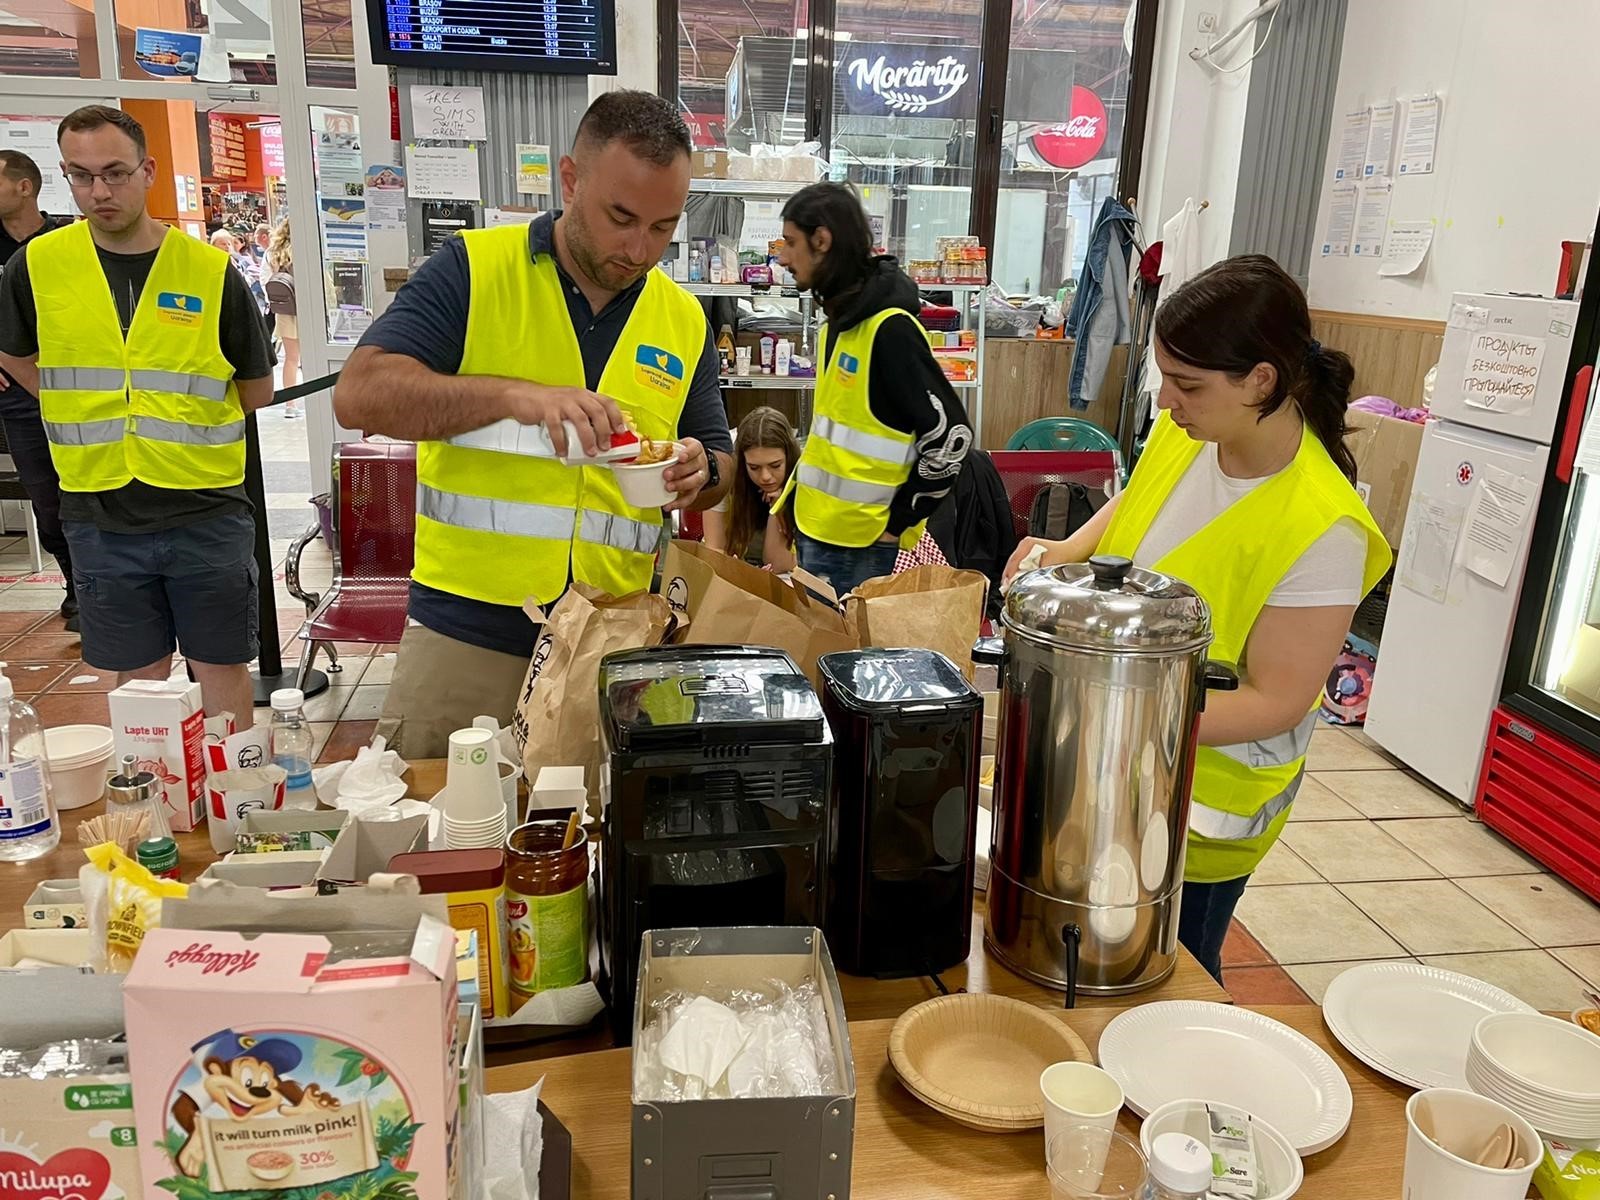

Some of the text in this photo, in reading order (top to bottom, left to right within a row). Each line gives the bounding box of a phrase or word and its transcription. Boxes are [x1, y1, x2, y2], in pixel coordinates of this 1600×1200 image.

[424, 89, 463, 104] FREE
[433, 105, 476, 123] SIMS
[439, 121, 464, 129] WITH
[124, 725, 169, 736] Lapte UHT
[164, 943, 260, 977] Kellogg's
[214, 1115, 357, 1142] it will turn milk pink!
[300, 1151, 334, 1165] 30%
[1229, 1166, 1248, 1176] Sare
[1571, 1164, 1600, 1175] No
